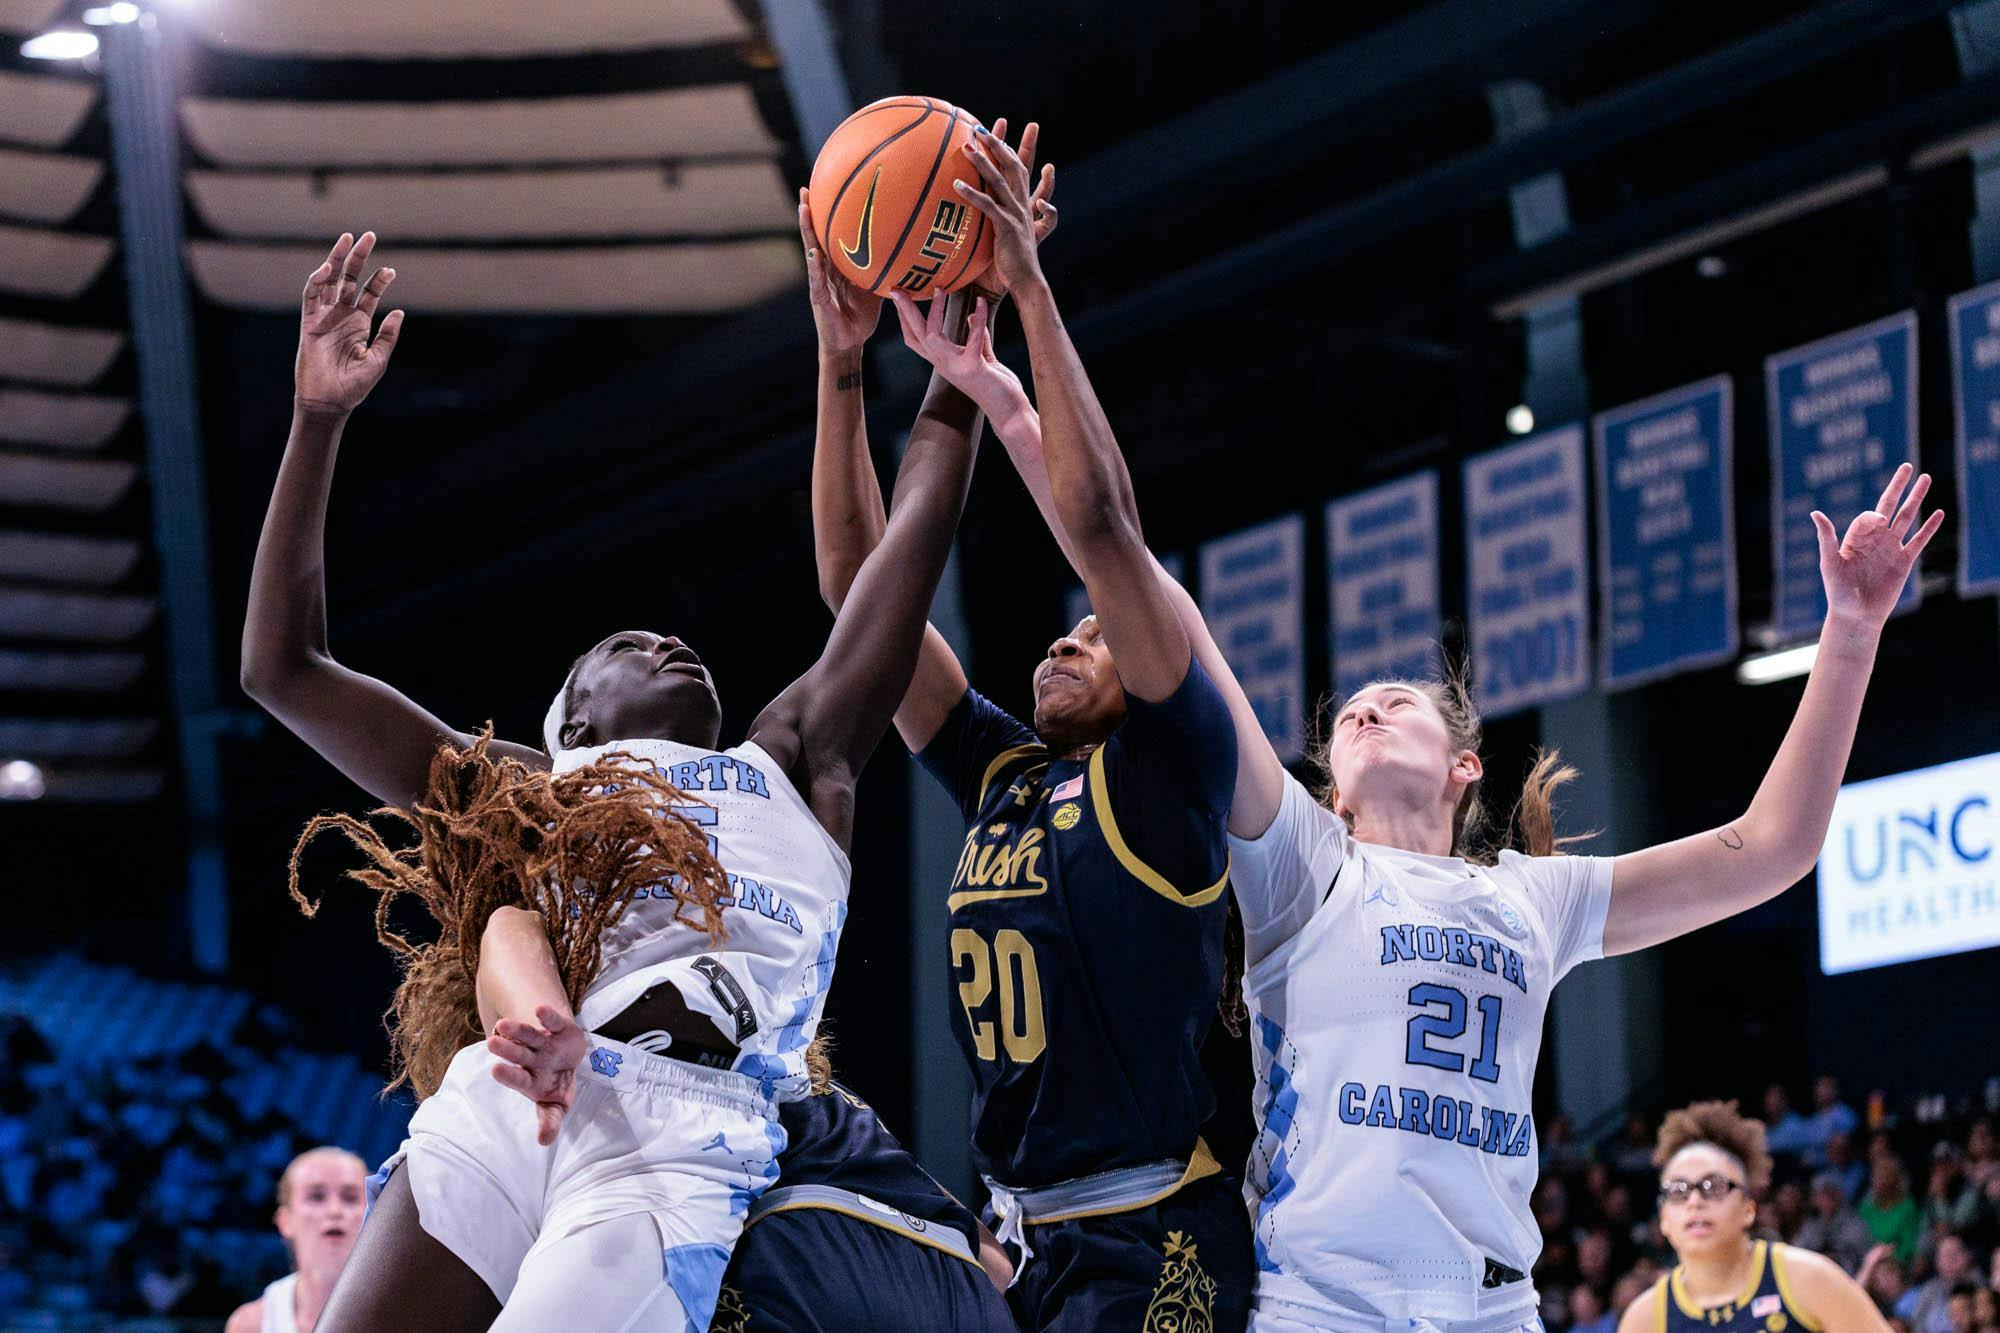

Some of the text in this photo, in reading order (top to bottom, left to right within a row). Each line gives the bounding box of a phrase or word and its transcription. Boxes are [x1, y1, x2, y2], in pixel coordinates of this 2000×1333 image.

[896, 199, 966, 292] ELITE
[1845, 797, 1992, 884] UNC
[1847, 880, 1995, 936] HEALTH
[951, 928, 1046, 1063] 20
[1380, 924, 1527, 993] NORTH
[1405, 981, 1503, 1083] 21
[1338, 1082, 1531, 1157] CAROLINA
